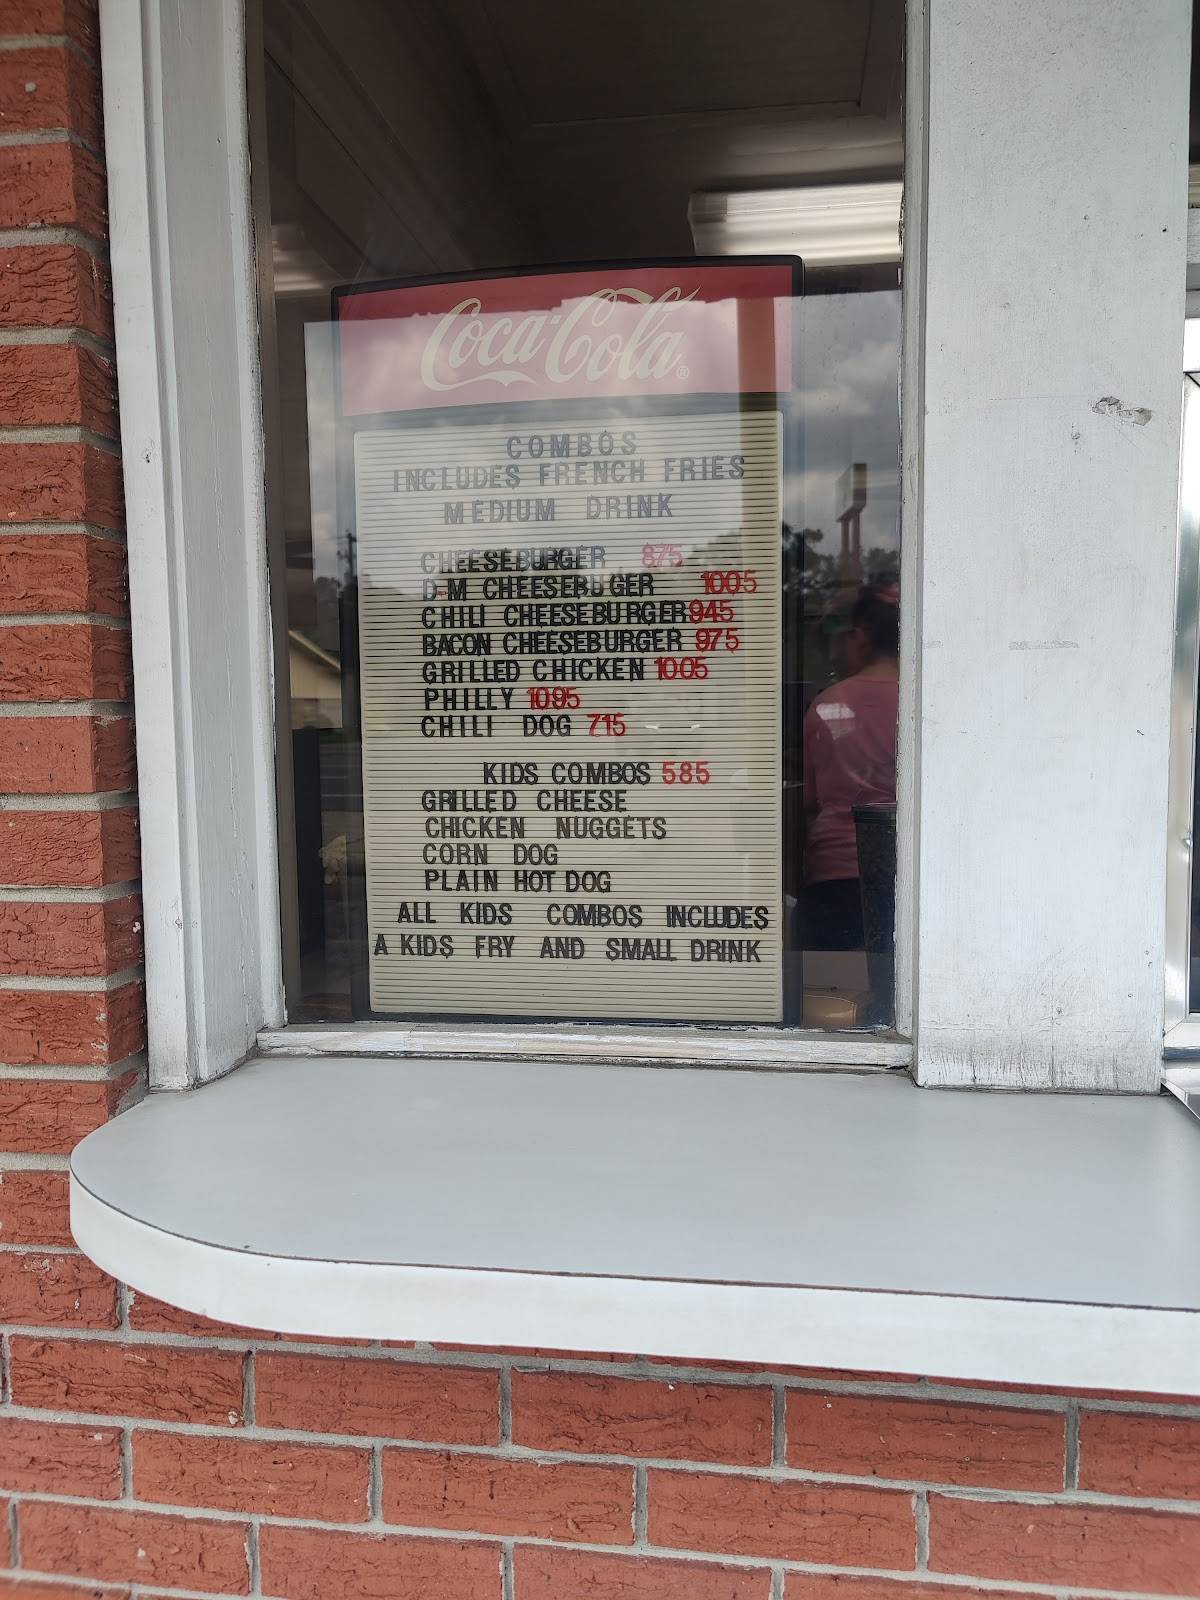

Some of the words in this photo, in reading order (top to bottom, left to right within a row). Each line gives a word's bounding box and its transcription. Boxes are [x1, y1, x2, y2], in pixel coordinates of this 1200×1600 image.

[421, 286, 701, 391] Coca-Cola
[506, 431, 637, 459] COMBOS
[393, 464, 520, 492] INCLUDES
[539, 458, 645, 486] FRENCH
[664, 455, 745, 483] FRIES
[444, 498, 555, 525] MEDIUM
[586, 493, 673, 520] DRINK
[420, 545, 606, 574] CHEESEBURGER
[641, 544, 684, 568] 875
[422, 578, 467, 601] D-M
[701, 570, 757, 595] 1005
[421, 604, 485, 629] CHILI
[503, 600, 687, 627] CHEESEBURGER
[688, 599, 735, 624] 945
[422, 632, 492, 656] BACON
[502, 628, 683, 655] CHEESEBURGER
[695, 627, 740, 652] 975
[422, 659, 521, 684] GRILLED
[532, 657, 645, 681] CHICKEN
[654, 656, 709, 681] 1005
[424, 687, 515, 711] PHILLY
[526, 686, 581, 710] 1095
[421, 714, 493, 737] CHILI
[523, 714, 571, 737] DOG
[586, 712, 626, 736] 715
[483, 762, 539, 785] KIDS
[551, 761, 651, 785] COMBOS
[661, 761, 710, 785] 585
[421, 789, 517, 812] GRILLED
[536, 789, 627, 812] CHEESE
[425, 816, 525, 839] CHICKEN
[556, 815, 667, 840] NUGGETS
[422, 843, 488, 865] CORN
[513, 843, 558, 865] DOG
[424, 869, 498, 892] PLAIN
[514, 870, 556, 892] HOT
[565, 870, 611, 893] DOG
[398, 902, 437, 924] ALL
[460, 902, 513, 925] KIDS
[547, 903, 643, 928] COMBOS
[666, 904, 769, 930] INCLUDES
[374, 933, 388, 956] A
[400, 933, 454, 959] KIDS
[475, 935, 515, 958] FRY
[540, 936, 585, 960] AND
[606, 937, 677, 961] SMALL
[690, 938, 761, 963] DRINK
